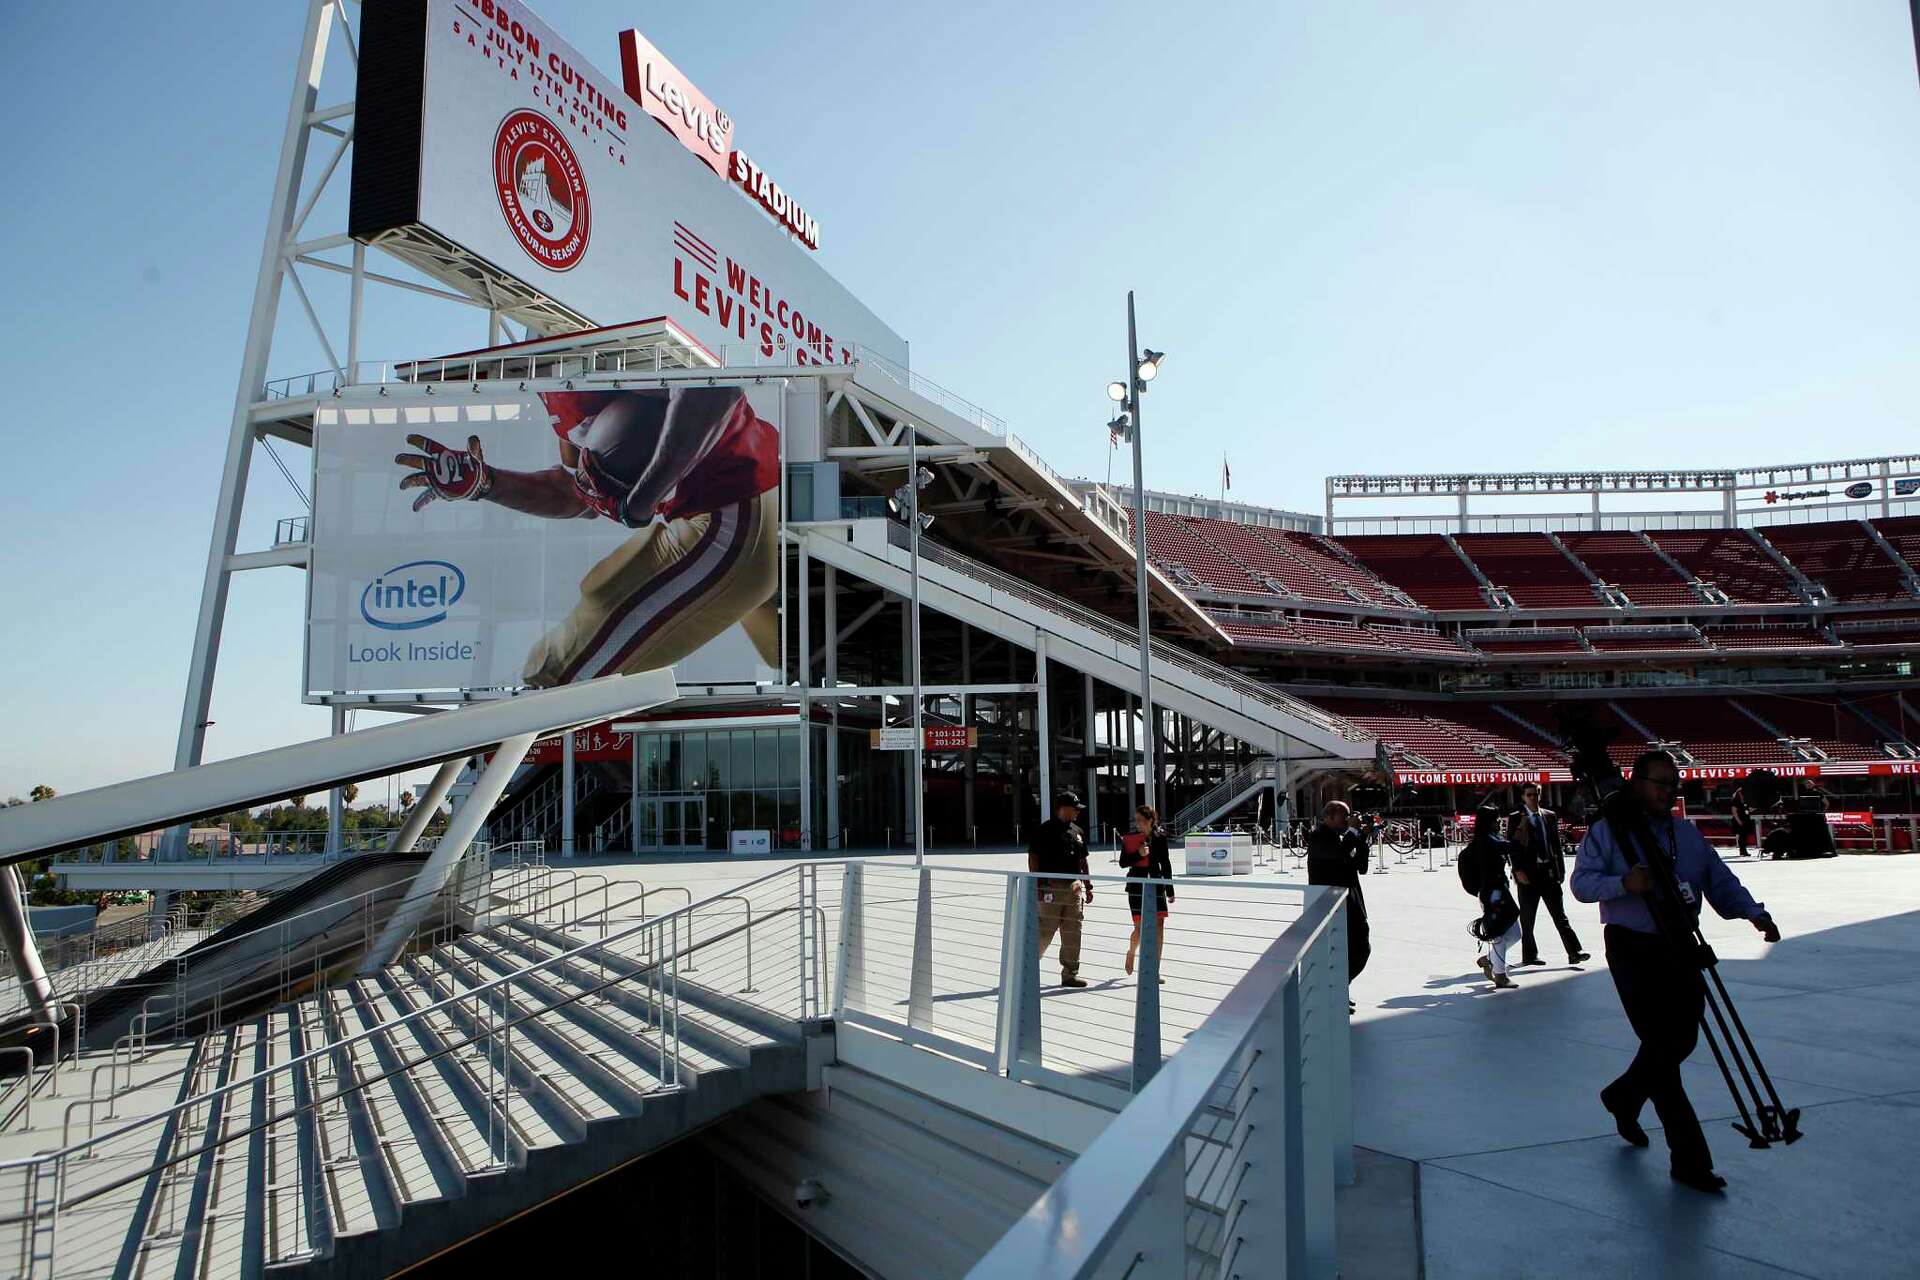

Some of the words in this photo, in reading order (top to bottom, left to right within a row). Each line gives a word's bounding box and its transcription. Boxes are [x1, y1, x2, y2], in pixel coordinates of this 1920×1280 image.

[487, 28, 523, 65] JULY
[573, 97, 603, 130] 2014
[548, 53, 627, 131] CUTTING
[454, 21, 518, 81] SANTA
[608, 145, 626, 166] CA
[542, 127, 582, 192] STADIUM
[733, 149, 820, 249] STADIUM
[504, 189, 551, 260] INAUGURAL
[551, 234, 581, 261] SEASON
[726, 256, 833, 364] WELCOME
[1807, 489, 1830, 497] Health
[1896, 481, 1920, 491] SAP
[375, 575, 447, 609] intel
[349, 641, 402, 663] Look
[934, 730, 966, 738] 101-123
[934, 738, 966, 746] 201-225
[1399, 773, 1447, 784] WELCOME
[1450, 773, 1462, 783] TO
[1501, 772, 1541, 782] STADIUM
[1745, 766, 1806, 777] SDIUM
[1890, 764, 1920, 774] WEL
